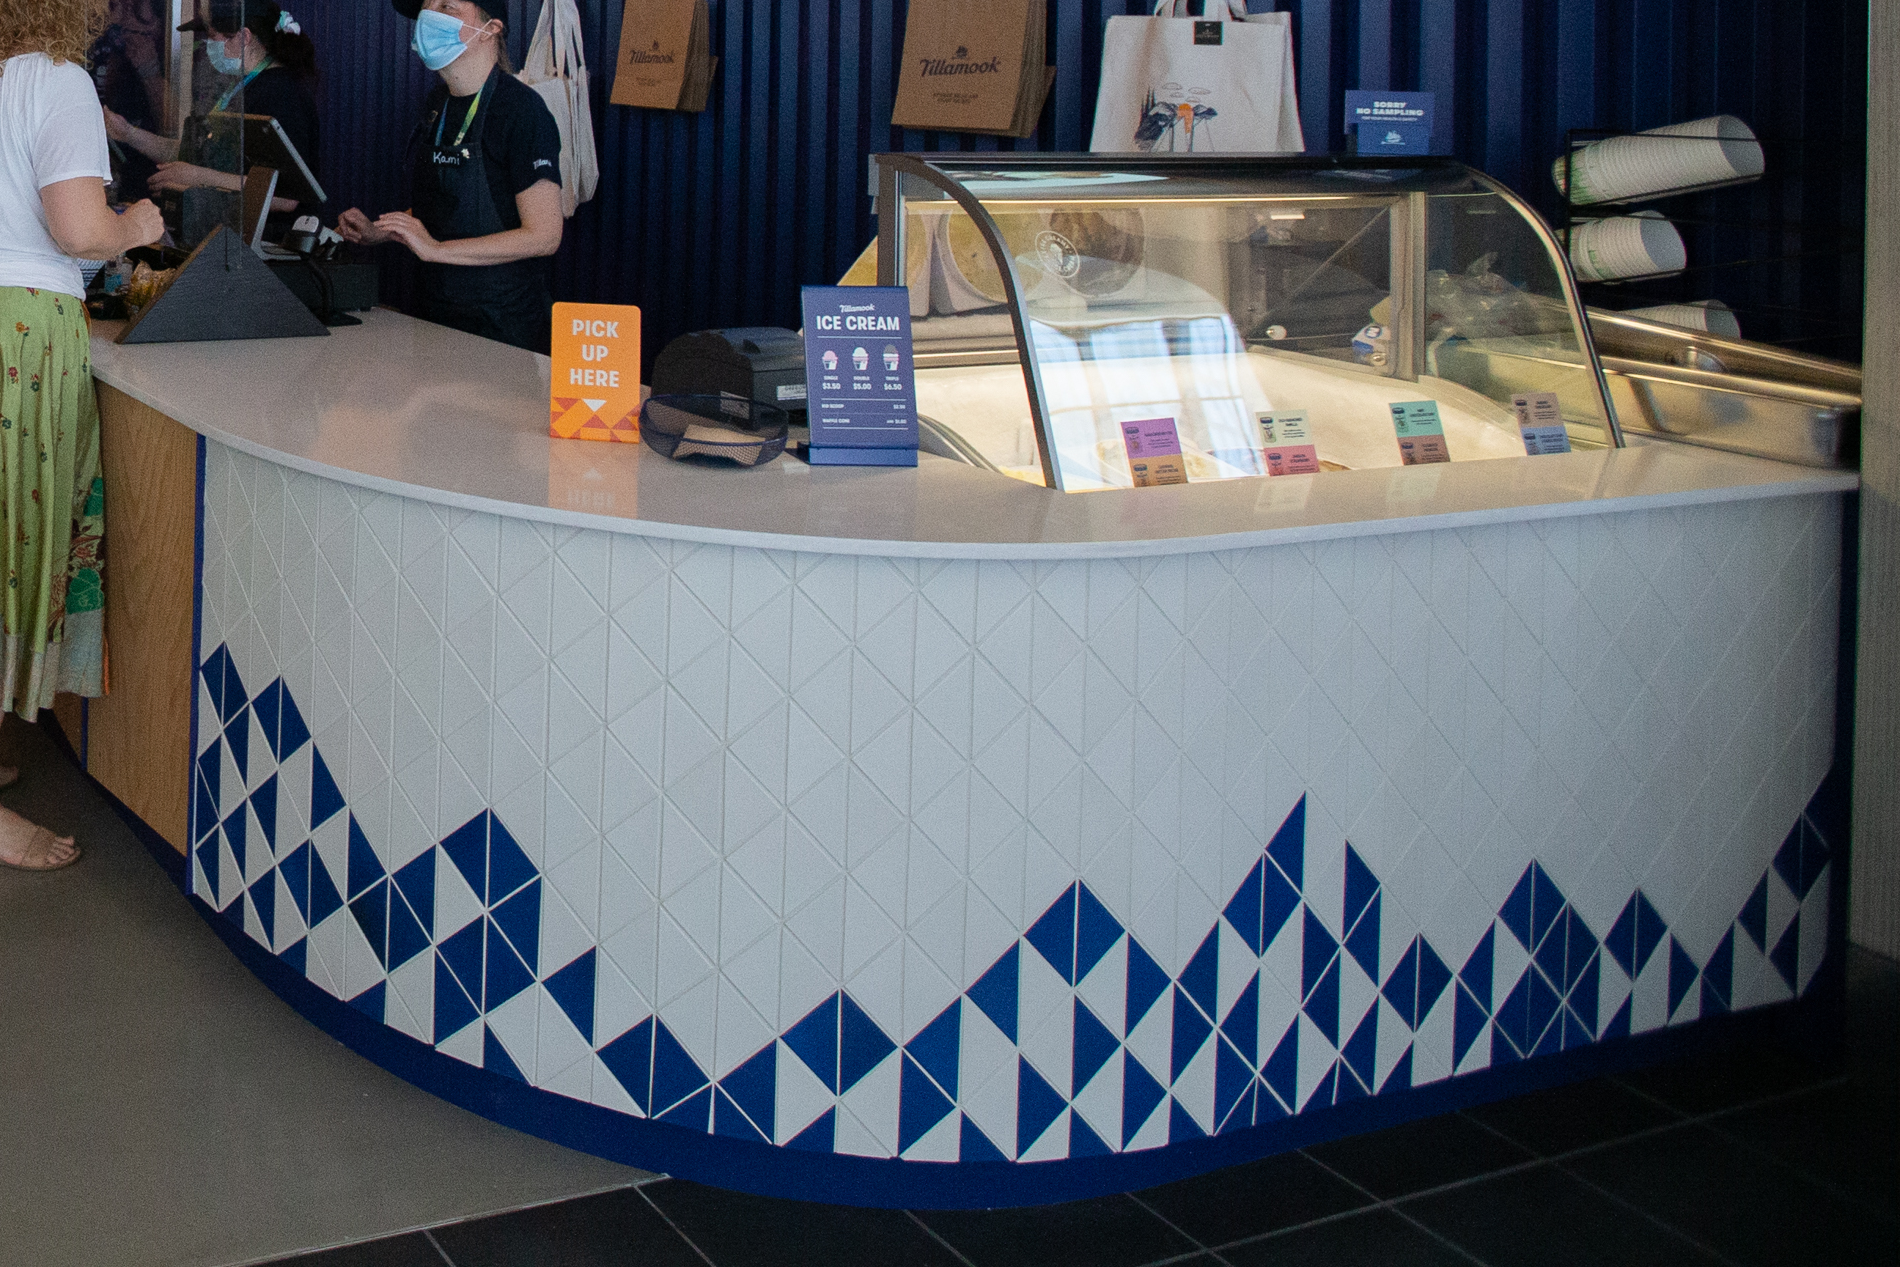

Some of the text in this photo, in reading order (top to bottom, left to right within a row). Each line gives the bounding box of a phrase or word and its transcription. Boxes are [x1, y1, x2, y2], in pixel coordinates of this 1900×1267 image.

[920, 56, 1001, 77] Tillamook
[1372, 108, 1424, 116] SAMPLING
[433, 151, 460, 165] Kami
[839, 303, 875, 313] Tillamook
[572, 319, 619, 338] PICK
[816, 315, 900, 331] ICE CREAM
[581, 345, 609, 362] UP
[569, 368, 620, 388] HERE
